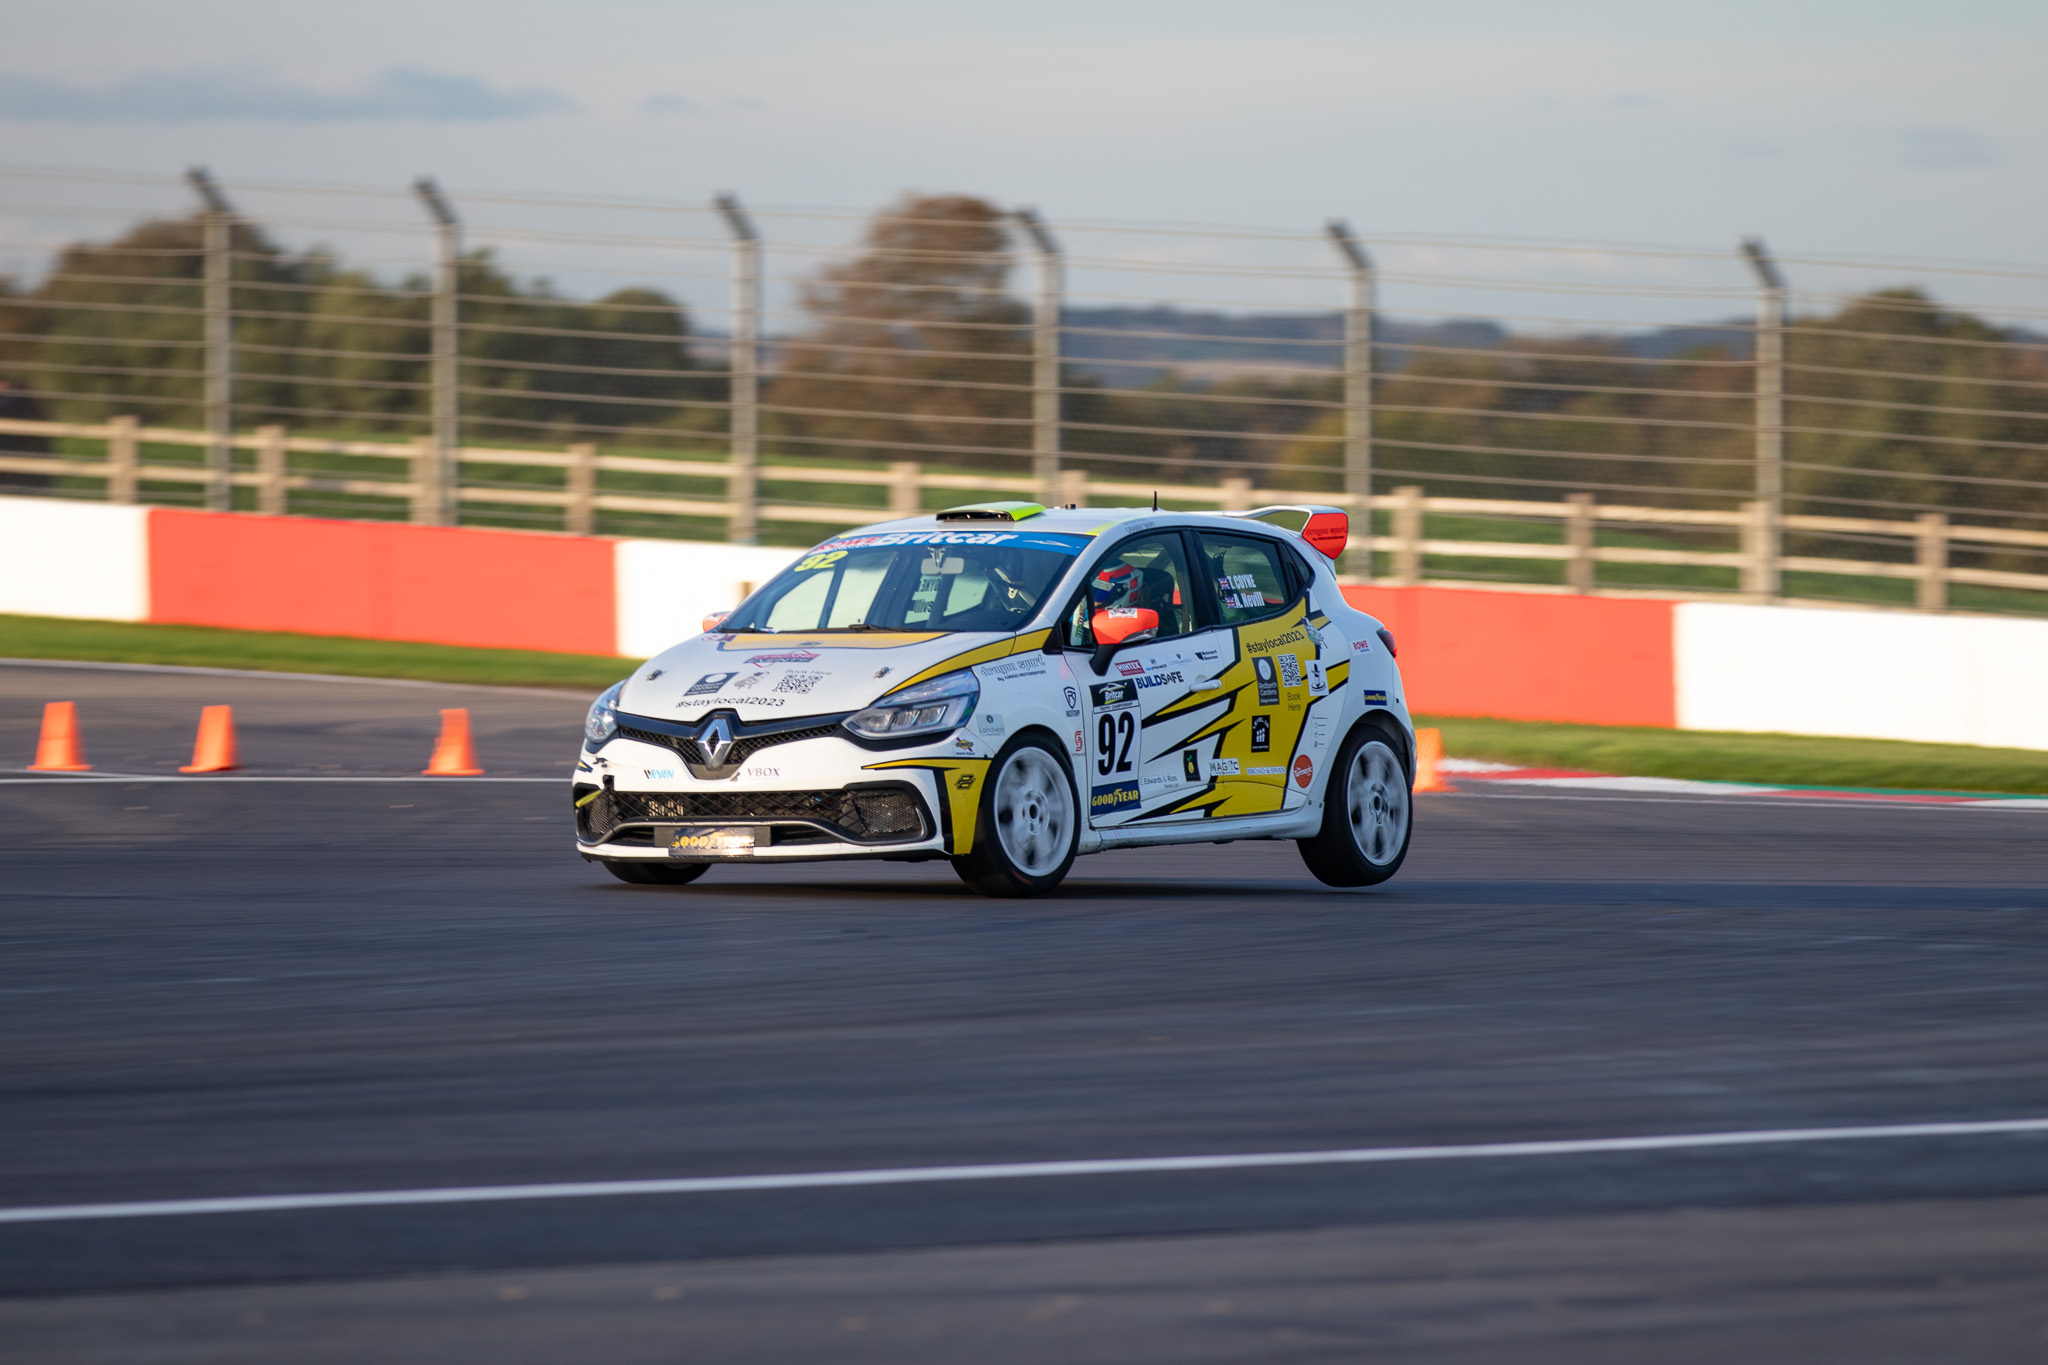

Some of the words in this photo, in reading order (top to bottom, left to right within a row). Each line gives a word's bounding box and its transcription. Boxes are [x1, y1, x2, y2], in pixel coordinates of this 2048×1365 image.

[876, 531, 1017, 546] Britcar
[795, 550, 848, 572] 92
[1246, 630, 1305, 654] #staylocal2023
[1116, 661, 1141, 672] MINTEX
[1136, 671, 1184, 689] BUILDSAFE
[676, 697, 785, 708] #staylocal2023
[1287, 692, 1300, 701] Book
[1288, 703, 1301, 711] Here
[1098, 711, 1135, 776] 92
[747, 768, 780, 777] VBOX
